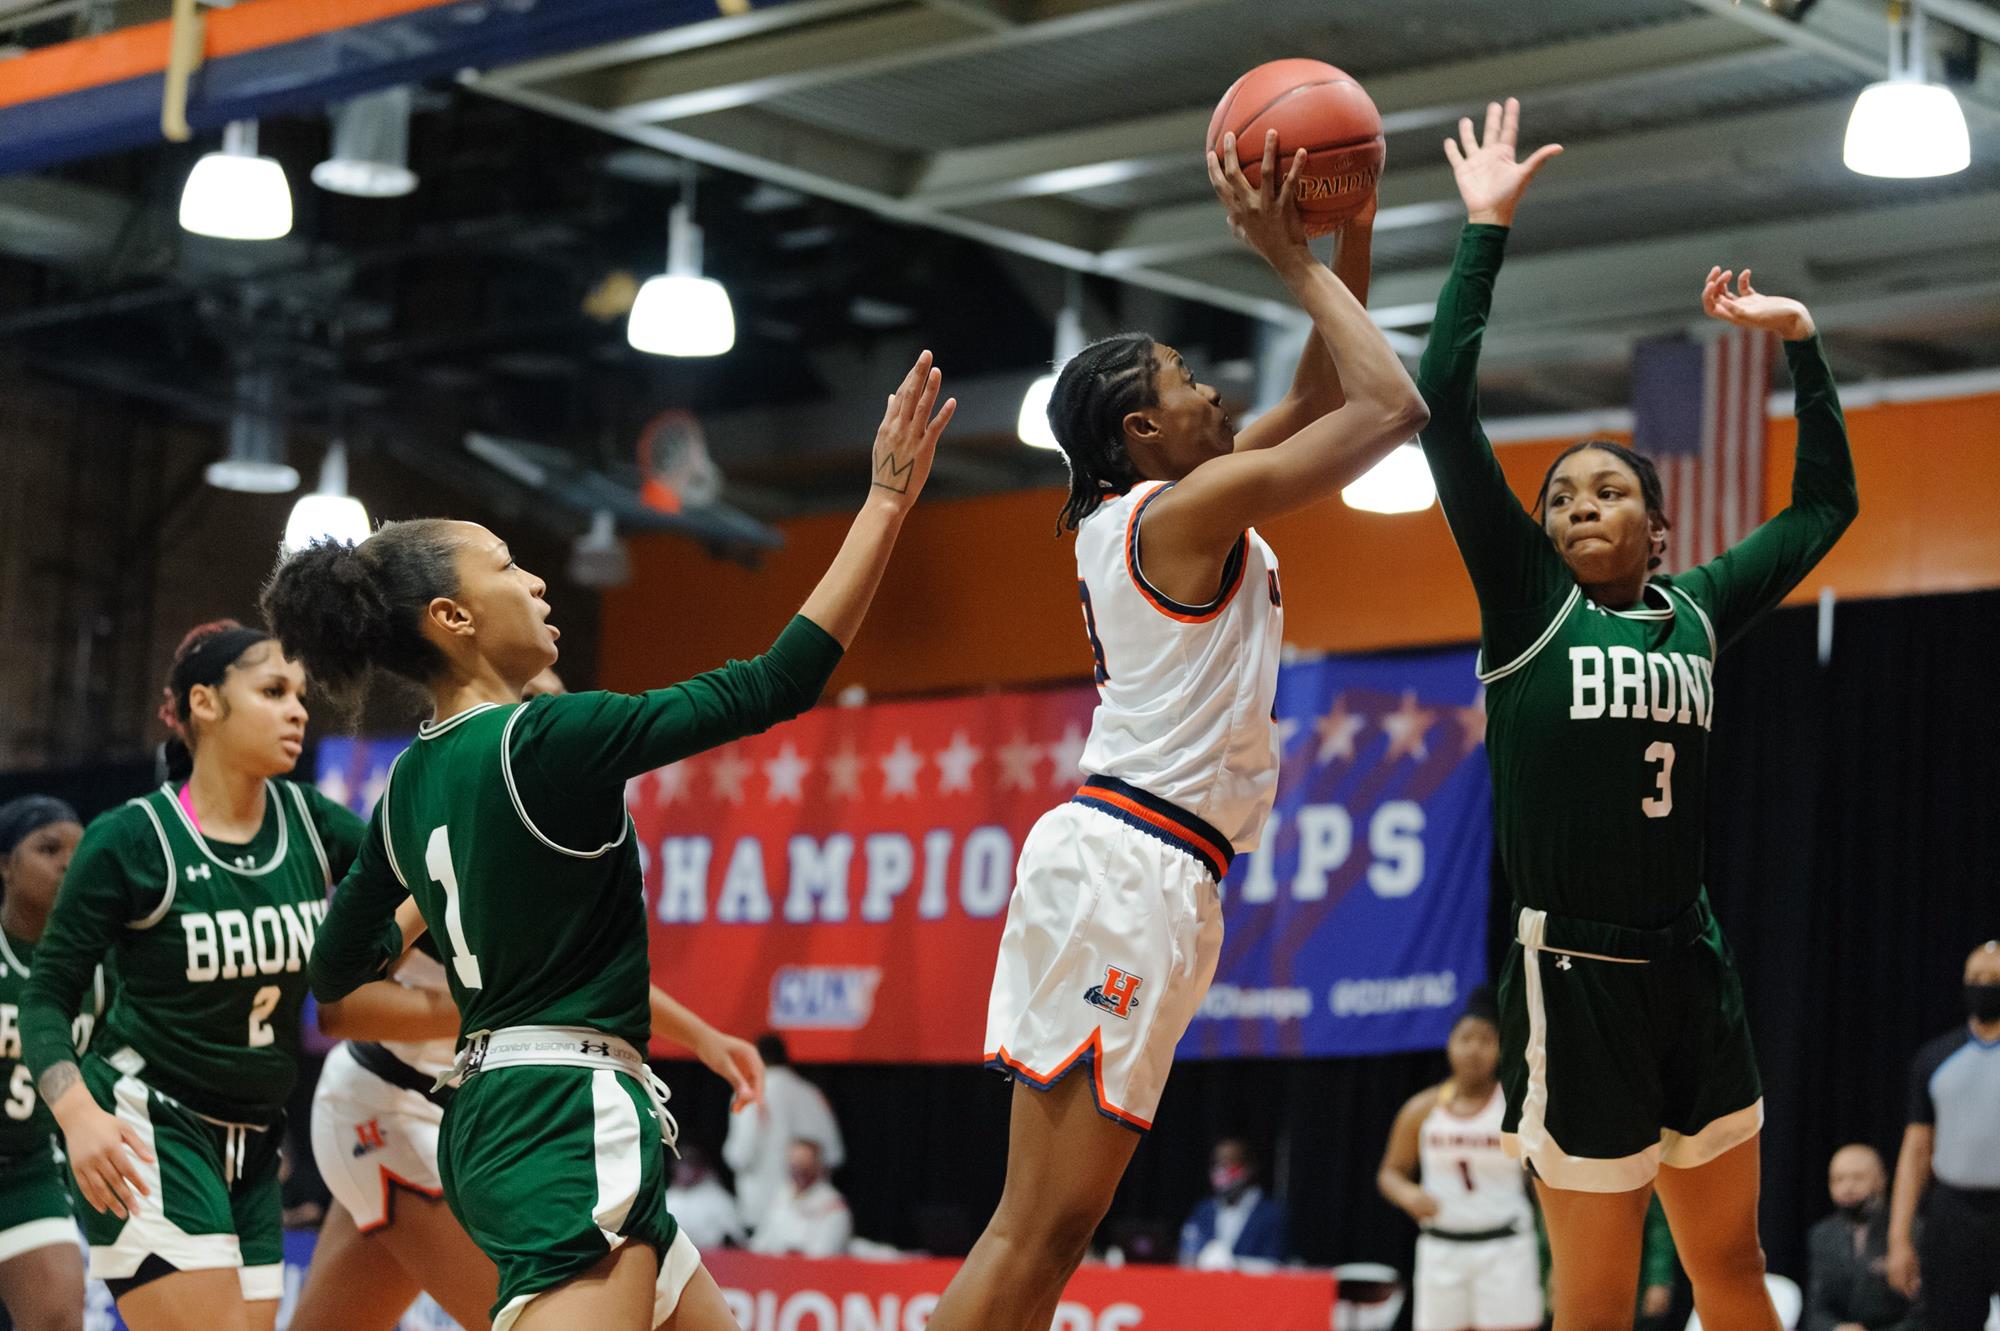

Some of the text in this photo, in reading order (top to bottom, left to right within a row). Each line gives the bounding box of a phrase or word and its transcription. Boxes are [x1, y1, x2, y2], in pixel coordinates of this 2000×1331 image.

[1283, 165, 1378, 201] PALDIN
[1641, 740, 1676, 818] 3
[425, 825, 483, 990] 1
[248, 985, 281, 1047] 2
[1104, 964, 1144, 1020] H
